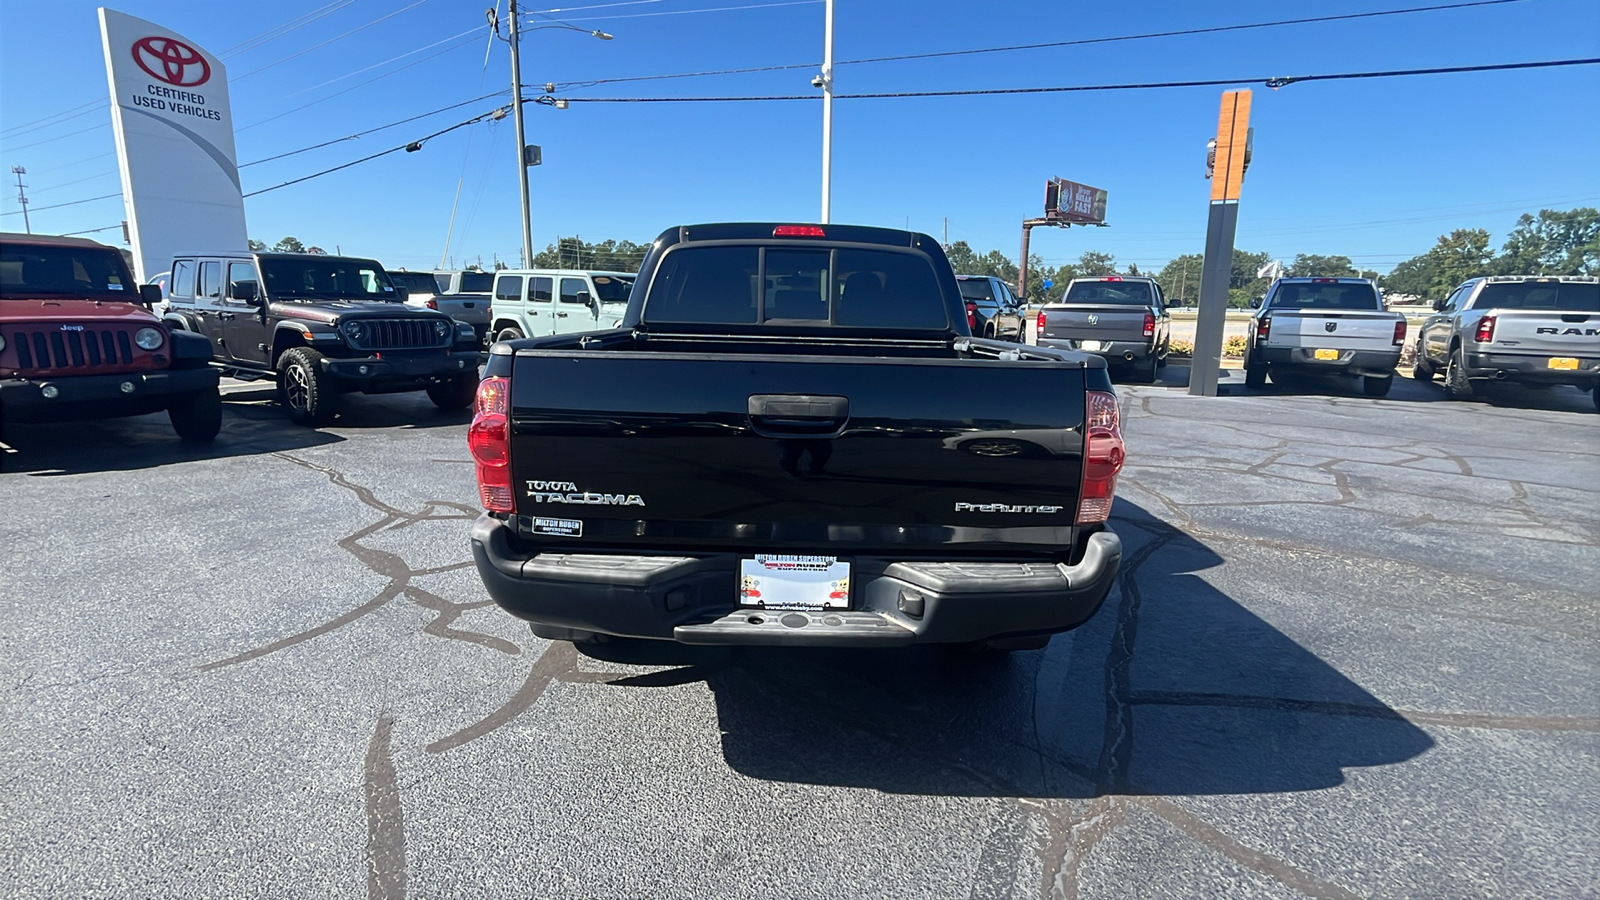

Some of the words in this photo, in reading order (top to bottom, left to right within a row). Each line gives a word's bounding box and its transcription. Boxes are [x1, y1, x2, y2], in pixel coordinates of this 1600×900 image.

[147, 85, 205, 105] CERTIFIED
[133, 94, 165, 110] USED
[169, 102, 221, 121] VEHICLES
[1074, 200, 1092, 214] FAST
[525, 480, 578, 492] TOYOTA
[526, 491, 646, 506] TACOMA
[954, 502, 1064, 513] PreRunner
[535, 518, 558, 527] MILTON
[558, 520, 580, 529] RUBEN
[798, 555, 837, 563] SUPERSTORE
